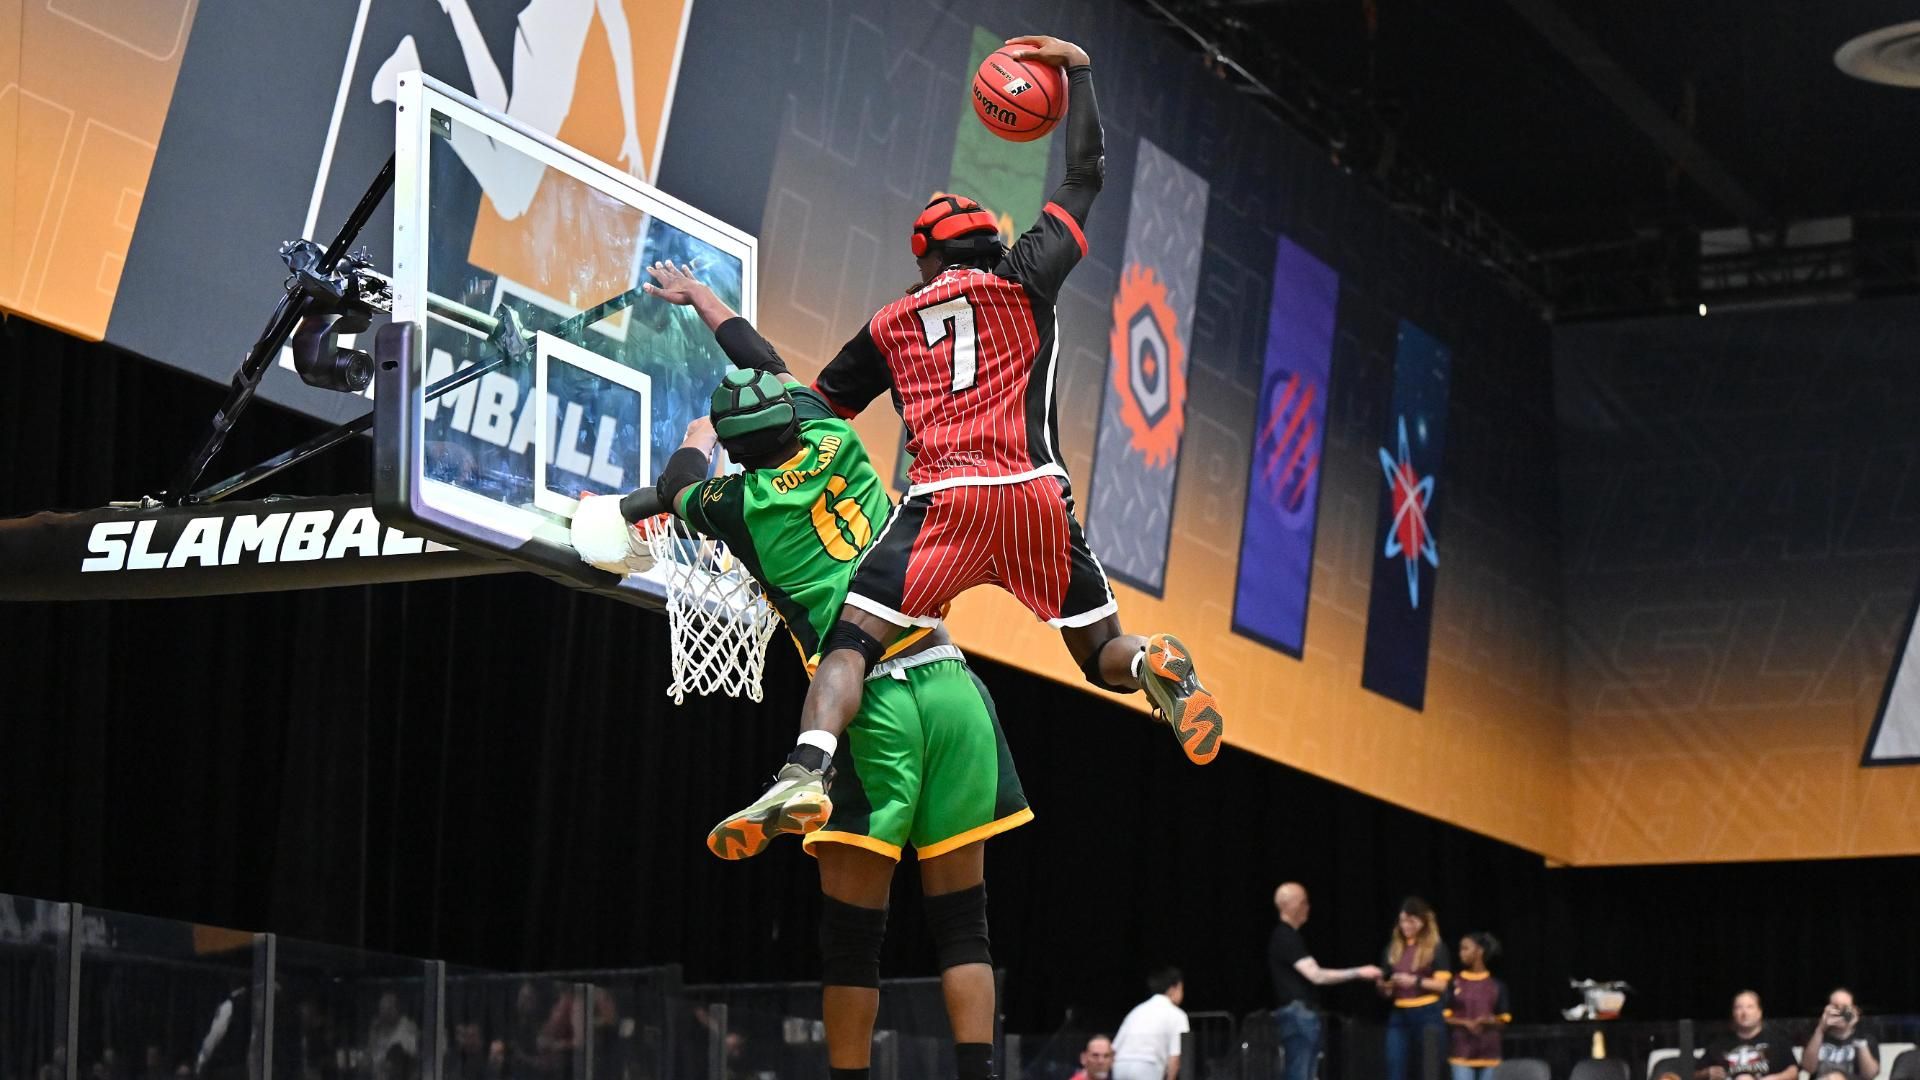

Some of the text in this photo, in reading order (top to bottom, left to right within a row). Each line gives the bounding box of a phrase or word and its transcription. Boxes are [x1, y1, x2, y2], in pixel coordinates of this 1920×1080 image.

[973, 82, 1017, 127] Wilson
[917, 294, 978, 394] 7
[81, 506, 459, 573] SLAMBAL
[810, 473, 872, 563] 6
